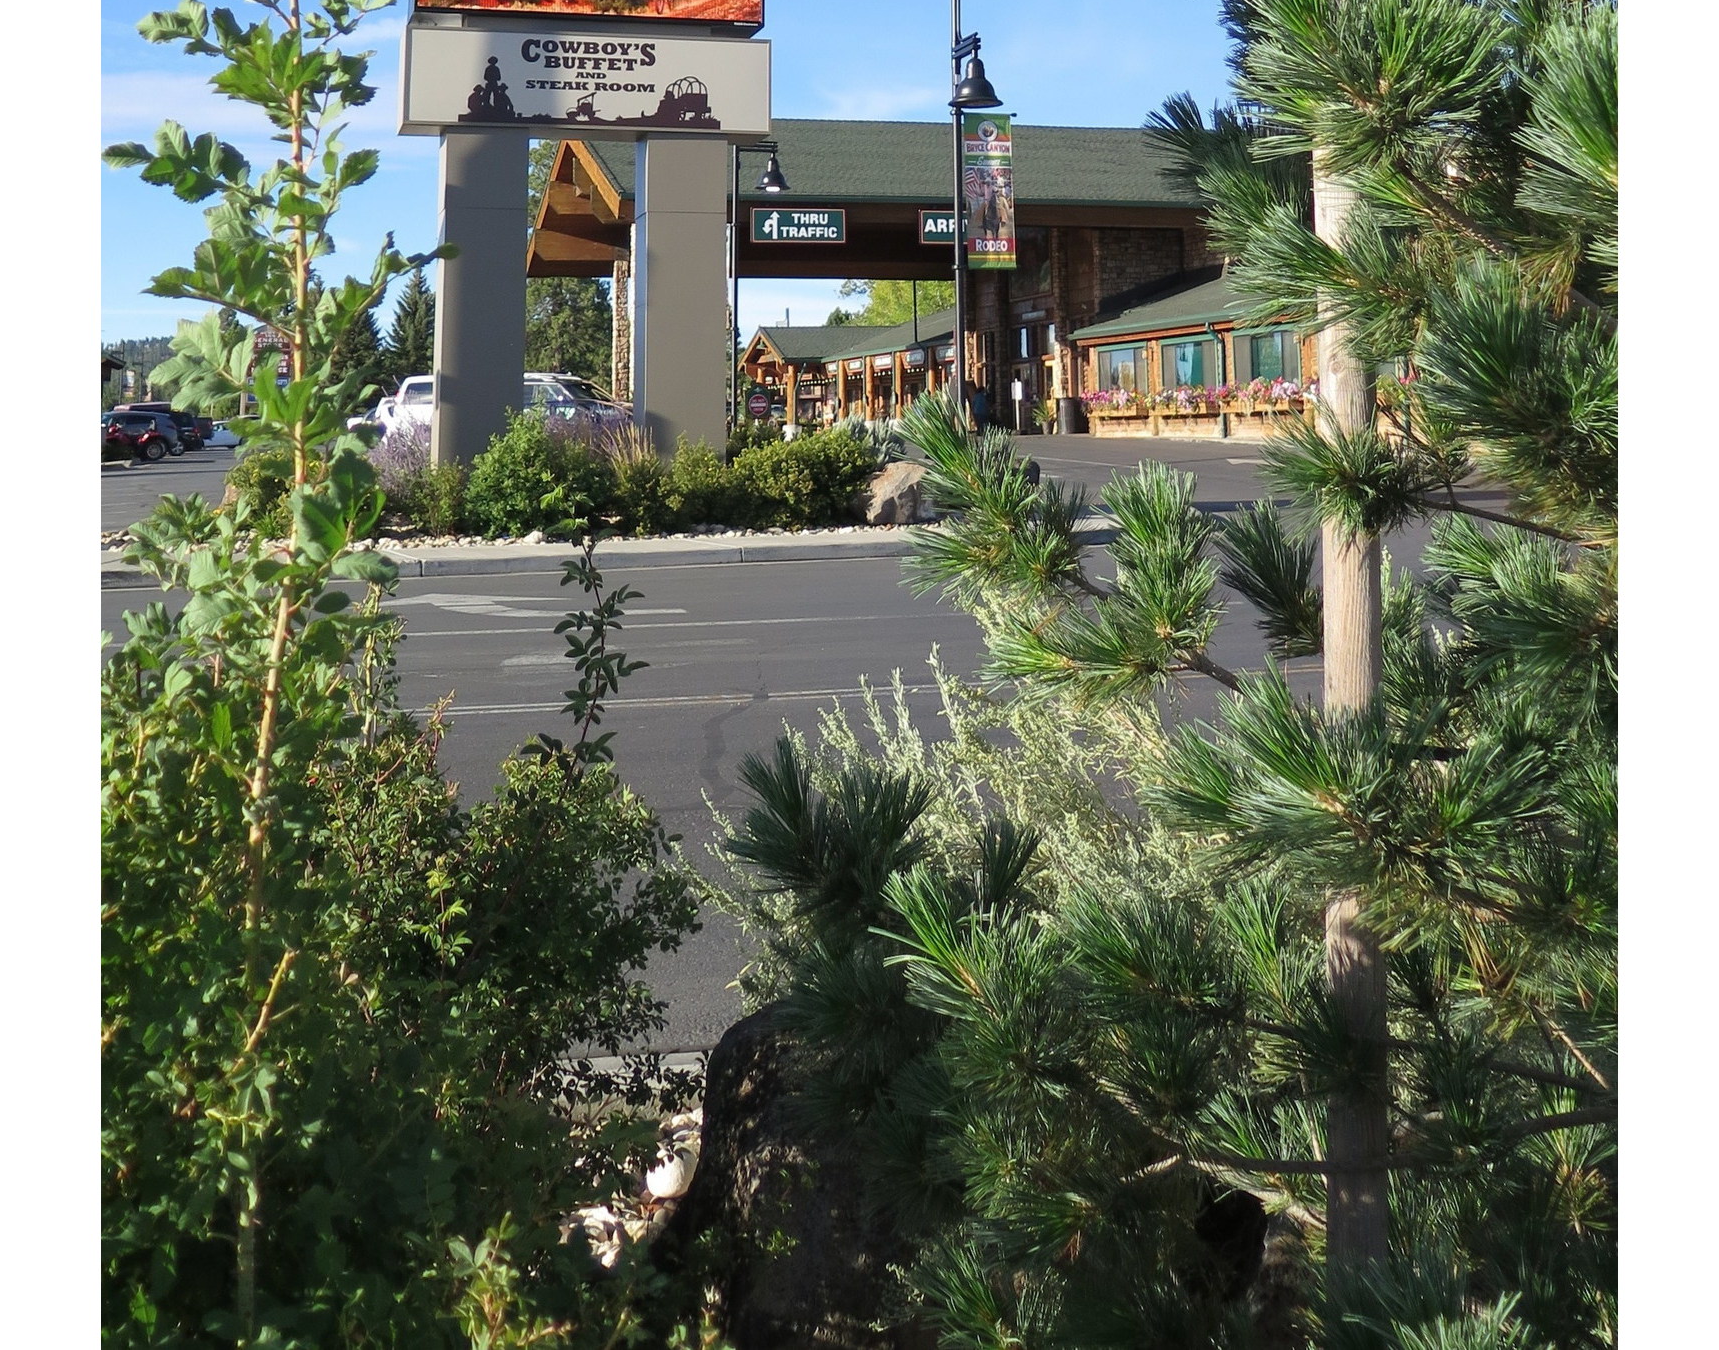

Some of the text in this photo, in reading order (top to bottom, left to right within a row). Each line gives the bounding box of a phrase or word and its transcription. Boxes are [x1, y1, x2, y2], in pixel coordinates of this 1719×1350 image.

[521, 38, 656, 67] COWBOY'S
[544, 55, 638, 71] BUFFET
[575, 71, 607, 80] AND
[525, 79, 656, 93] STEAK ROOM
[791, 213, 829, 225] THRU
[780, 226, 838, 238] TRAFFIC
[975, 239, 1008, 252] RODEO
